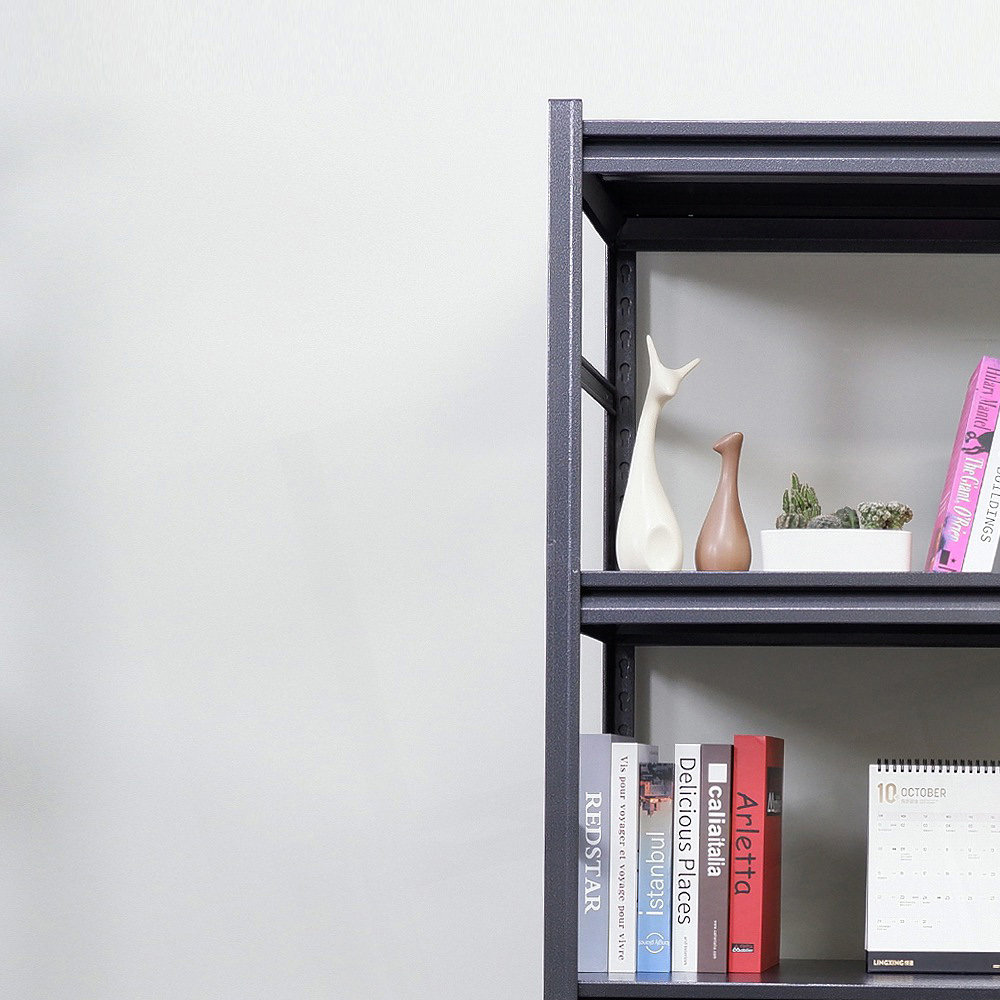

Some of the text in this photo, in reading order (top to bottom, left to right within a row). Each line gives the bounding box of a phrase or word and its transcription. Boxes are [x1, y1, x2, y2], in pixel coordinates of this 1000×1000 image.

[677, 758, 698, 925] Delicious Places
[707, 785, 725, 877] caliaitalia
[734, 792, 759, 895] Arletta
[877, 783, 946, 803] 10 OCTOBER
[585, 792, 602, 914] REDSTAR
[617, 756, 628, 961] Vis pour voyager et voyage pour vivre
